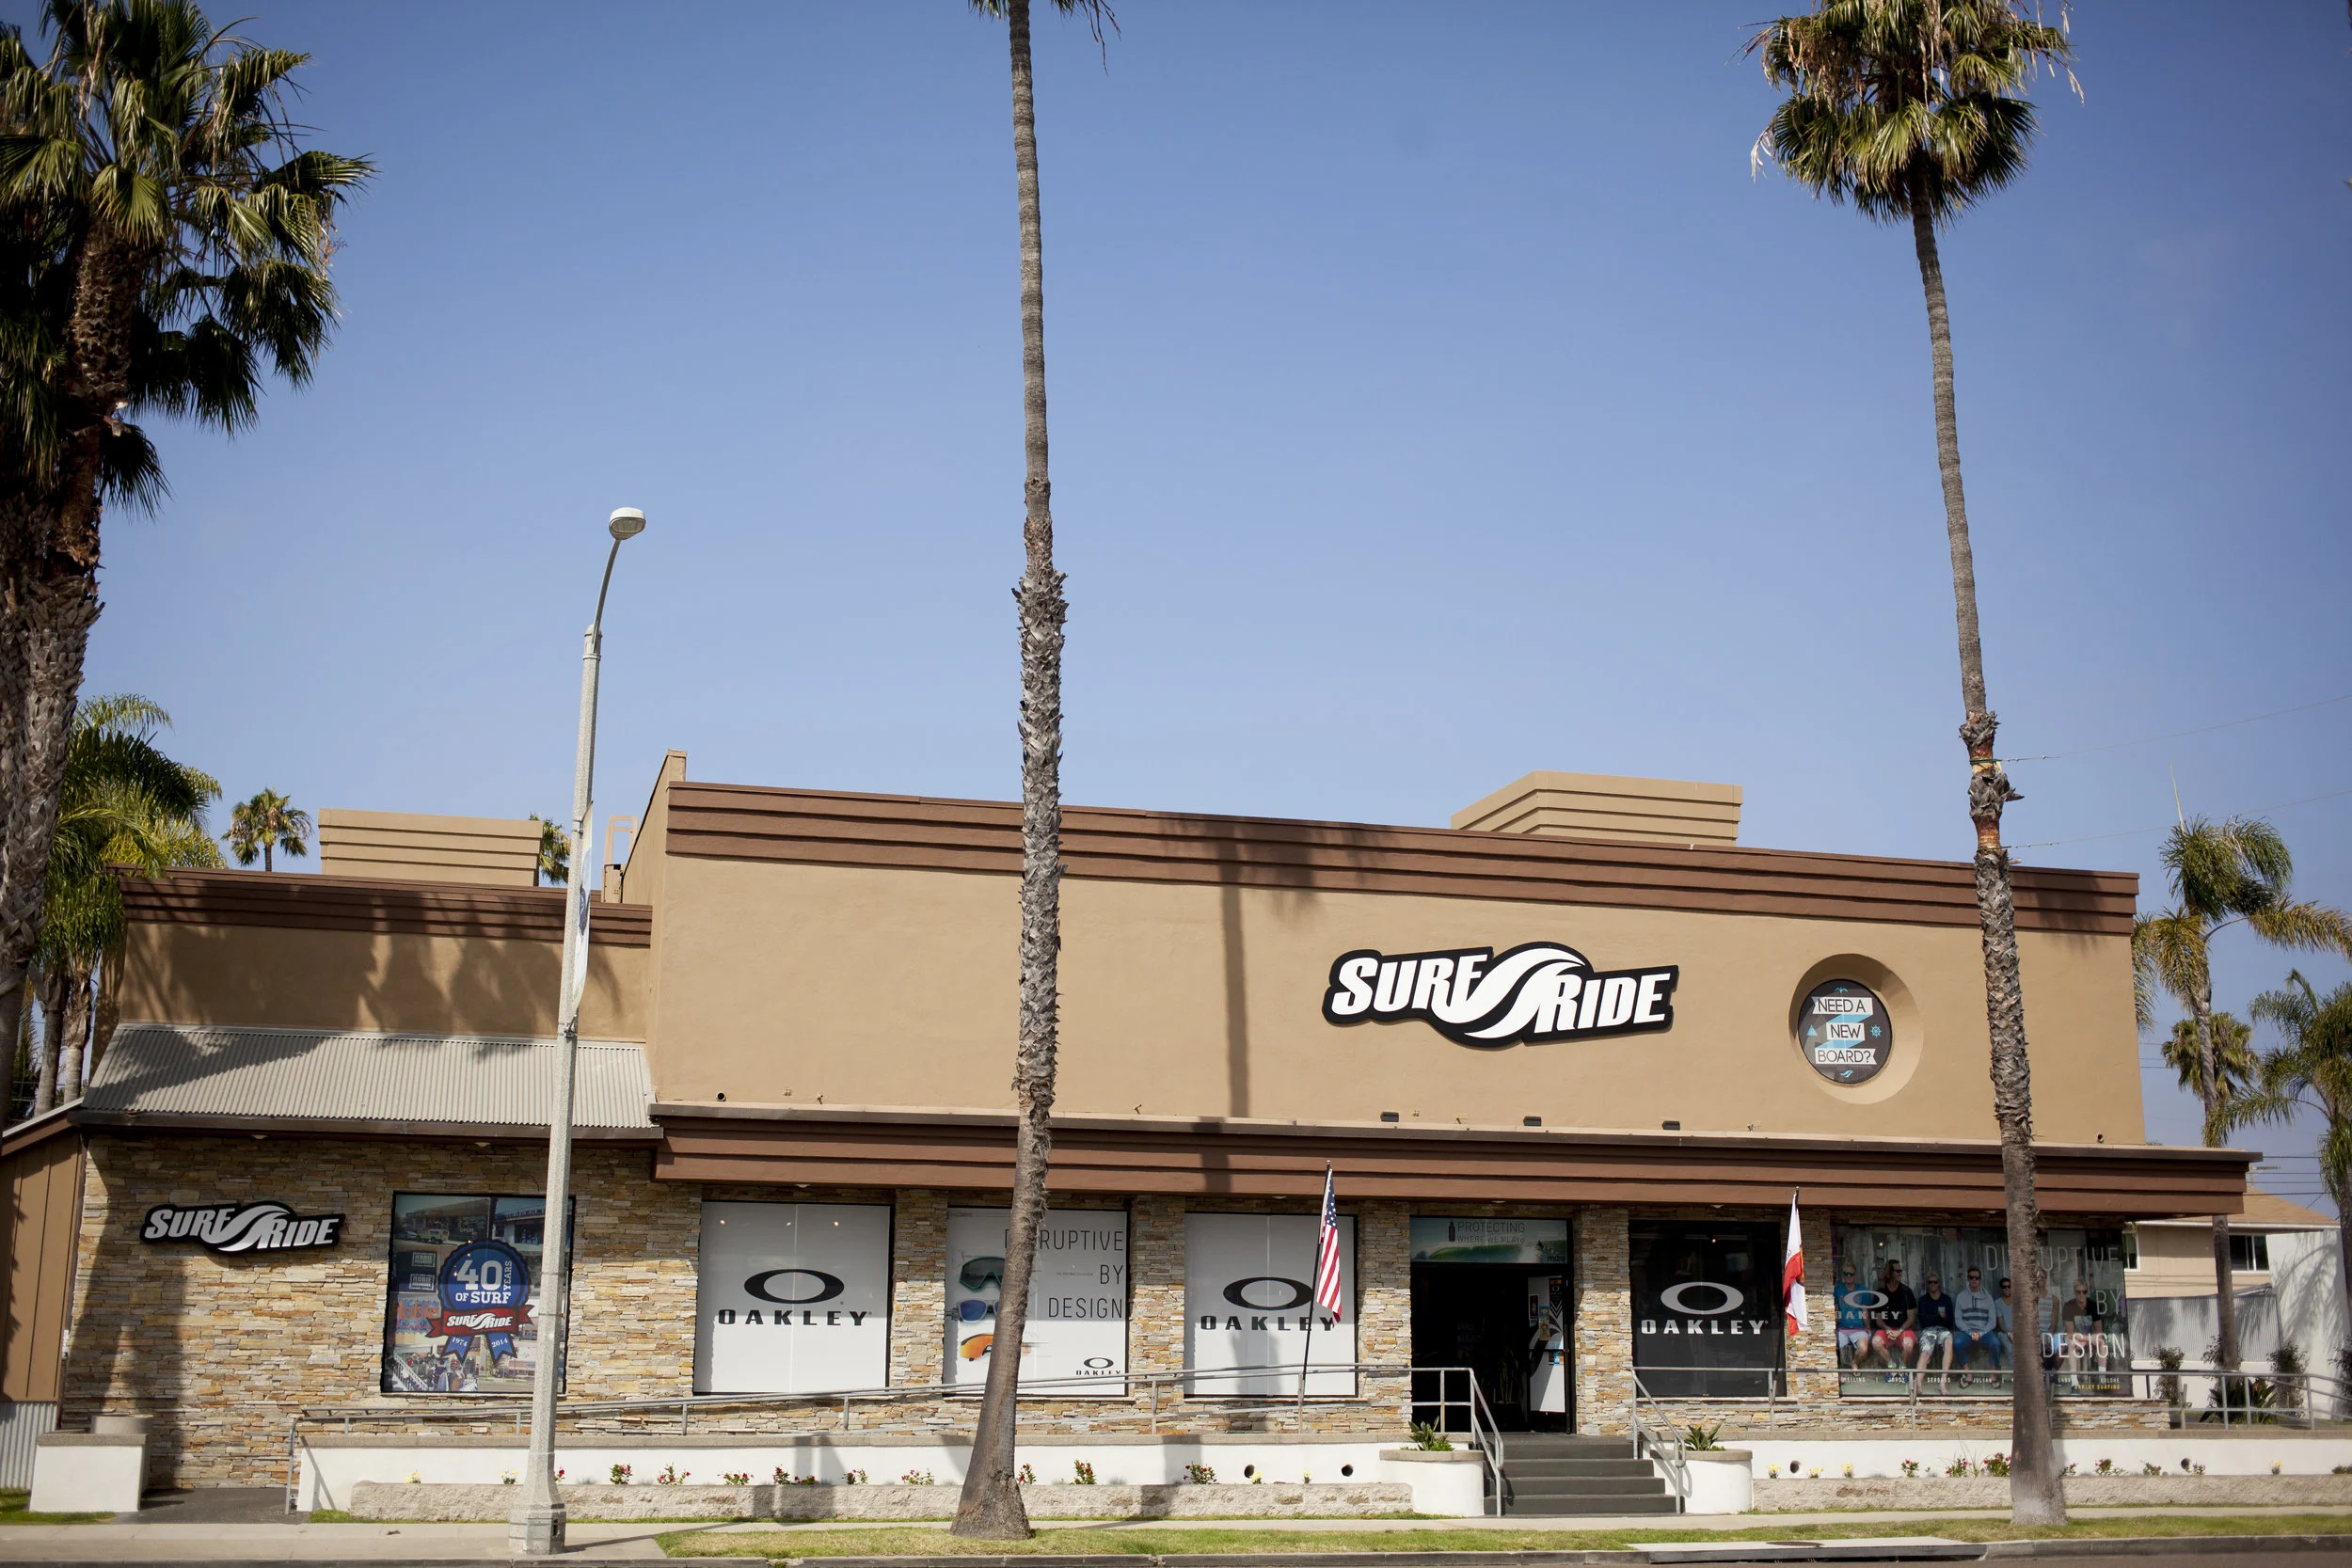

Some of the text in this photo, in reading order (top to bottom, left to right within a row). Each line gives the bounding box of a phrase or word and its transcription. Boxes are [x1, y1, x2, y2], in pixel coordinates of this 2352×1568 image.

[1331, 954, 1671, 1034] SURF RIDE
[1818, 998, 1867, 1013] NEED A
[1830, 1024, 1861, 1038] NEW
[1818, 1050, 1871, 1063] BOARD?
[144, 1208, 339, 1249] SURF RIDE
[1457, 1222, 1526, 1233] PROTECTING
[1005, 1228, 1123, 1251] RUPTIVE
[1985, 1245, 2119, 1271] DIUPTIVE
[456, 1259, 503, 1291] 40
[503, 1260, 512, 1291] YEARS
[1100, 1264, 1123, 1285] BY
[455, 1291, 512, 1305] OF SURF
[2095, 1290, 2122, 1315] BY
[1048, 1297, 1122, 1319] DESIGN
[1835, 1310, 1900, 1320] OAKLEY
[447, 1314, 514, 1328] SURF RIDE
[718, 1308, 867, 1326] OAKLEY
[1200, 1315, 1334, 1331] OAKLEY
[1641, 1319, 1764, 1335] OAKLEY
[452, 1337, 469, 1347] 1974
[491, 1338, 508, 1348] 2014
[2042, 1332, 2125, 1358] DESIGN
